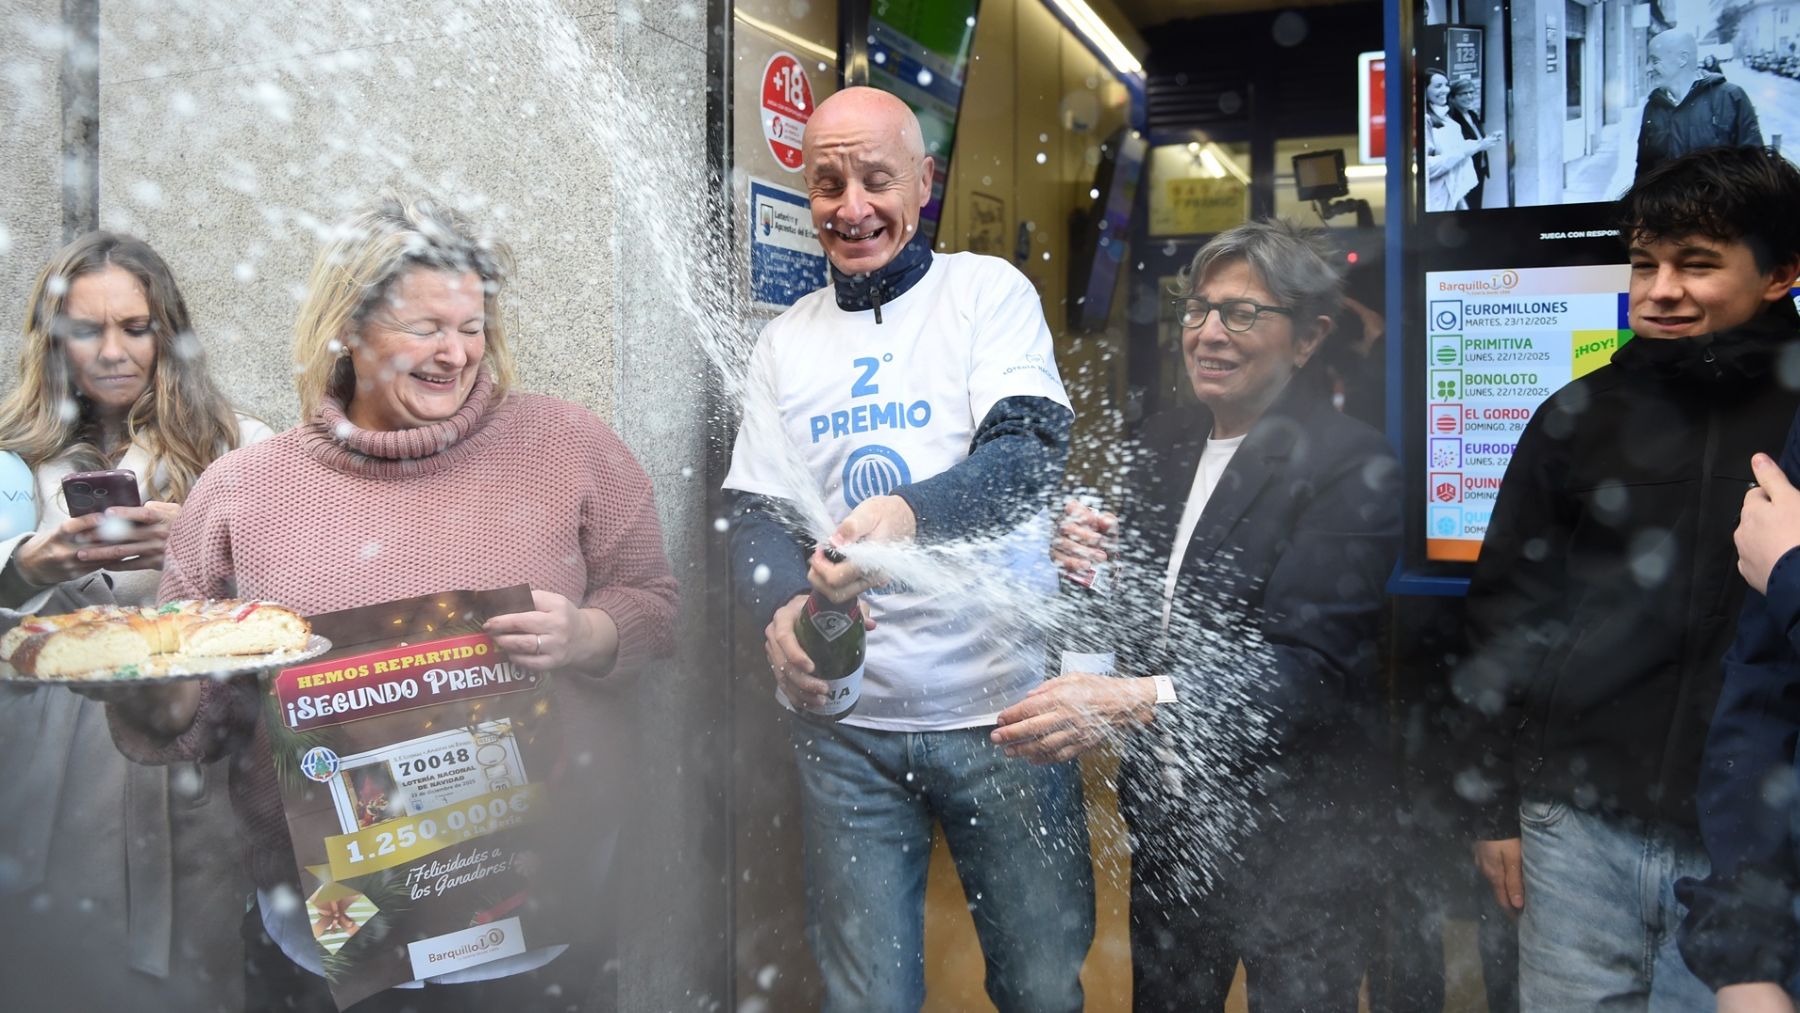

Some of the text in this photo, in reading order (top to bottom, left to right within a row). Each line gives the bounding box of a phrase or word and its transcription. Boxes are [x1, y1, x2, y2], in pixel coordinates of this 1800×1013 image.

[1456, 48, 1475, 62] 123
[773, 65, 804, 108] +18
[1540, 232, 1566, 240] JUEGA
[1567, 231, 1585, 239] CON
[1465, 302, 1568, 315] EUROMILLONES
[1504, 317, 1558, 327] 23/12/2025
[1465, 338, 1533, 350] PRIMITIVA
[1575, 338, 1615, 359] ¡HOY!
[1465, 352, 1550, 362] LUNES, 22/12/2025
[1465, 373, 1538, 385] BONOLOTO
[1465, 387, 1550, 397] LUNES, 22/12/2025
[810, 399, 931, 444] PREMIO
[1465, 408, 1530, 420] EL GORDO
[1464, 423, 1507, 432] DOMINGO,
[297, 643, 488, 689] HEMOS REPARTIDO
[287, 678, 419, 727] ¡SEGUNDO
[398, 748, 470, 777] 70048
[402, 765, 477, 788] LOTERÍA NACIONAL
[417, 776, 465, 791] DE NAVIDAD
[346, 791, 530, 864] 1.250.000€
[405, 847, 503, 887] ¡Felicidades a
[410, 853, 515, 901] los Ganadores!
[428, 943, 479, 963] Barquillo
